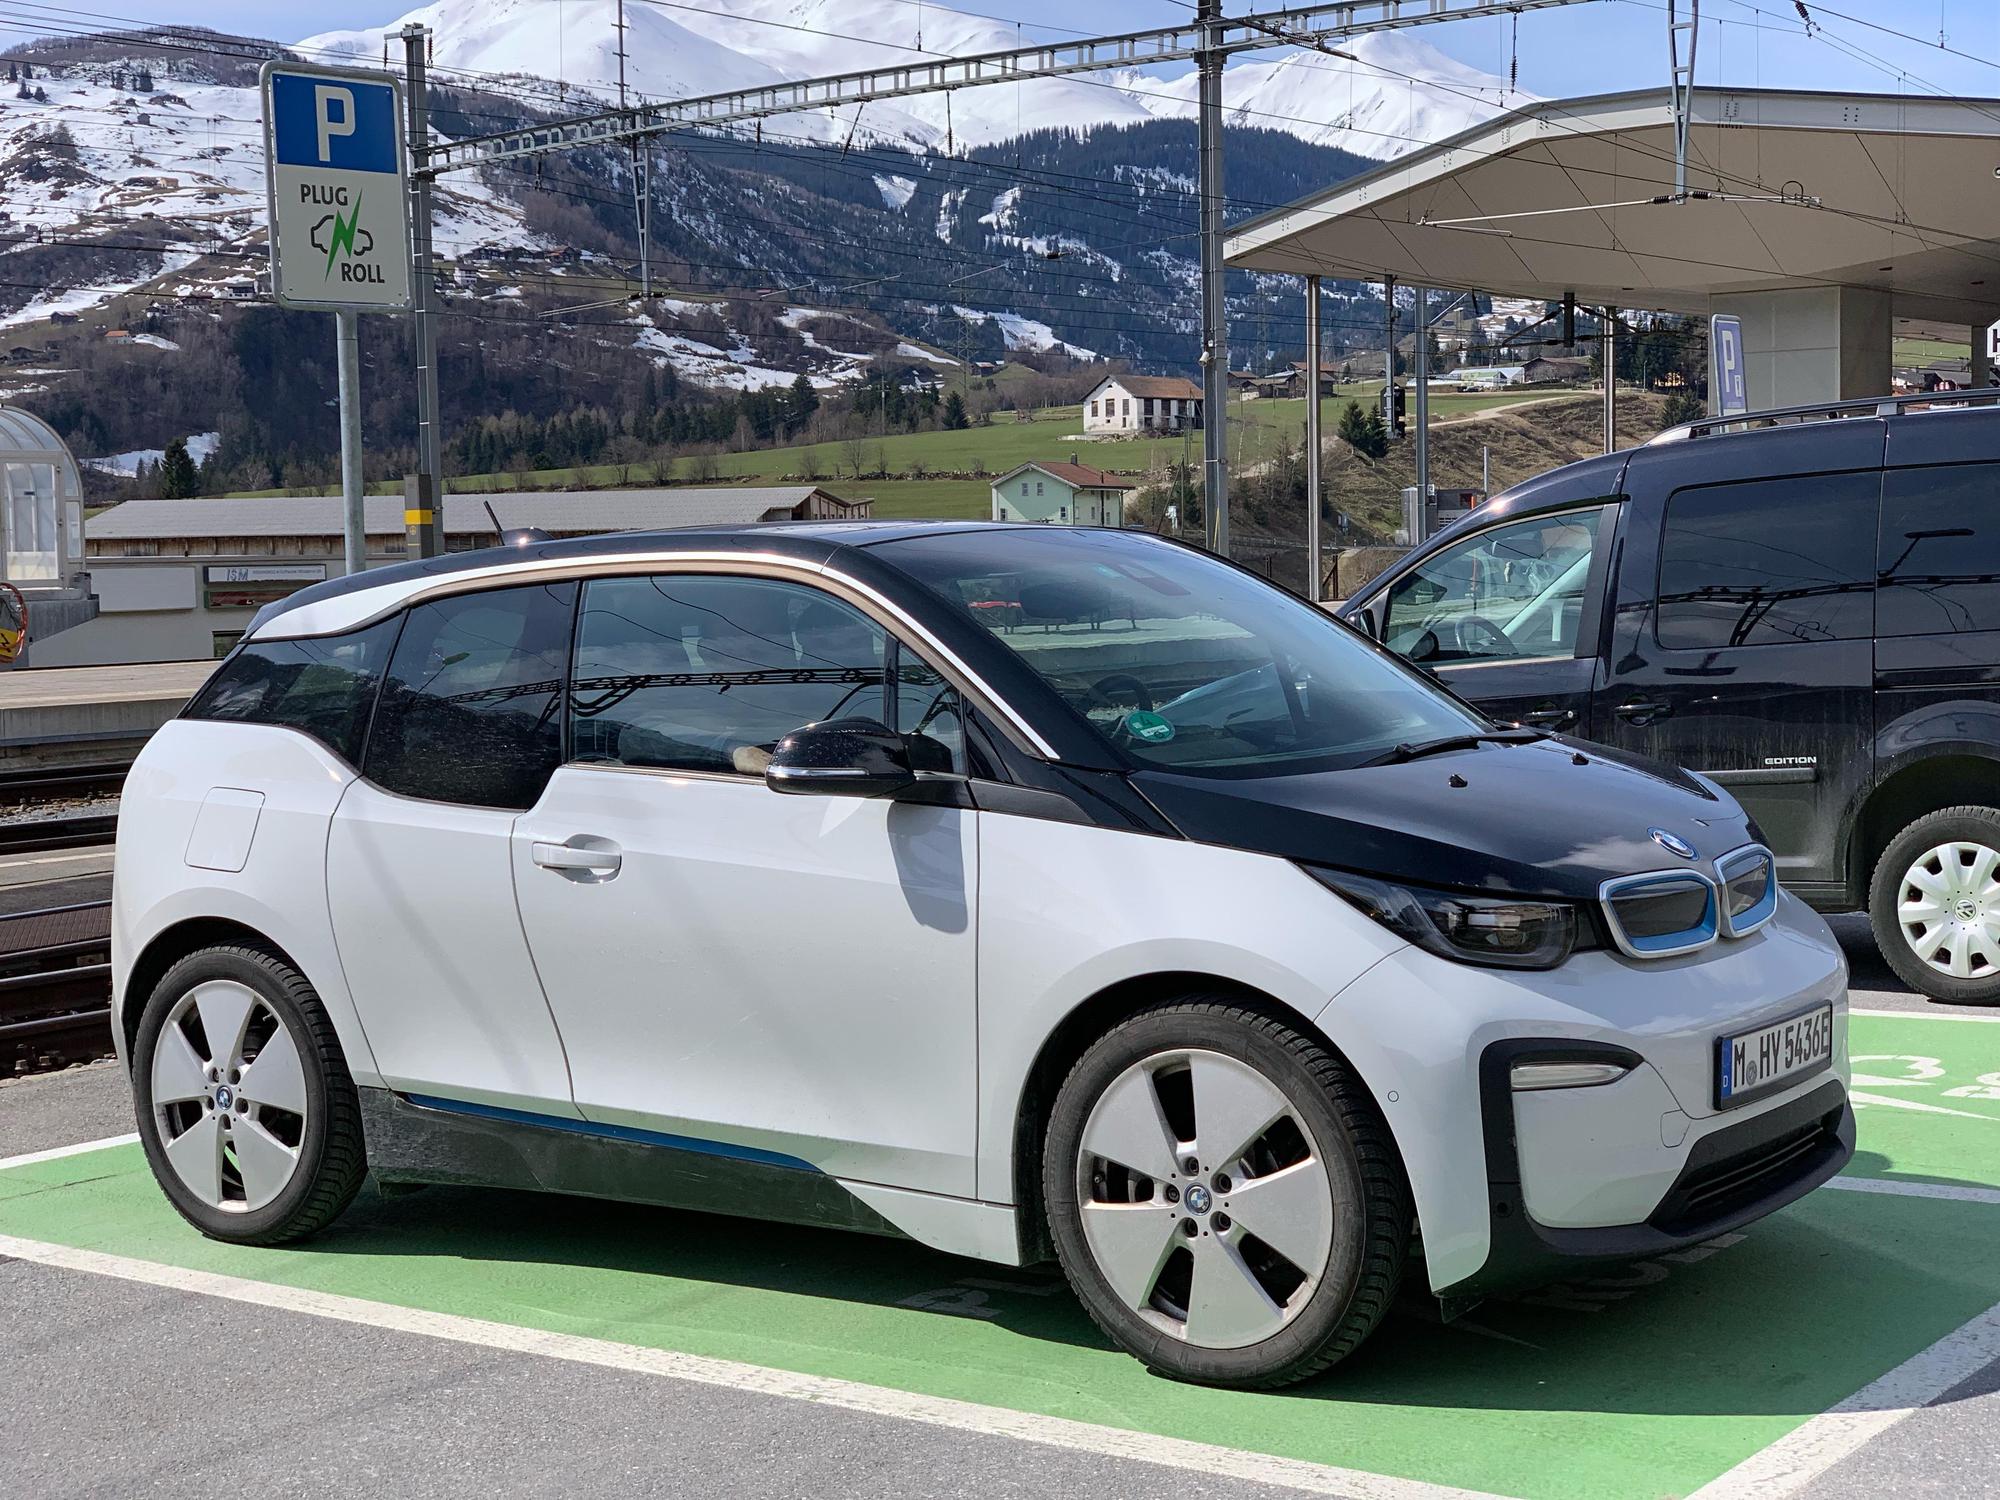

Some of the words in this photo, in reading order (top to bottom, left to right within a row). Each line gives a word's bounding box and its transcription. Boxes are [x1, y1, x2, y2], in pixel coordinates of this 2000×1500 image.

[315, 84, 355, 162] P
[300, 184, 348, 206] PLUG
[341, 263, 385, 283] ROLL
[1722, 331, 1735, 393] P
[1764, 756, 1817, 765] EDITION
